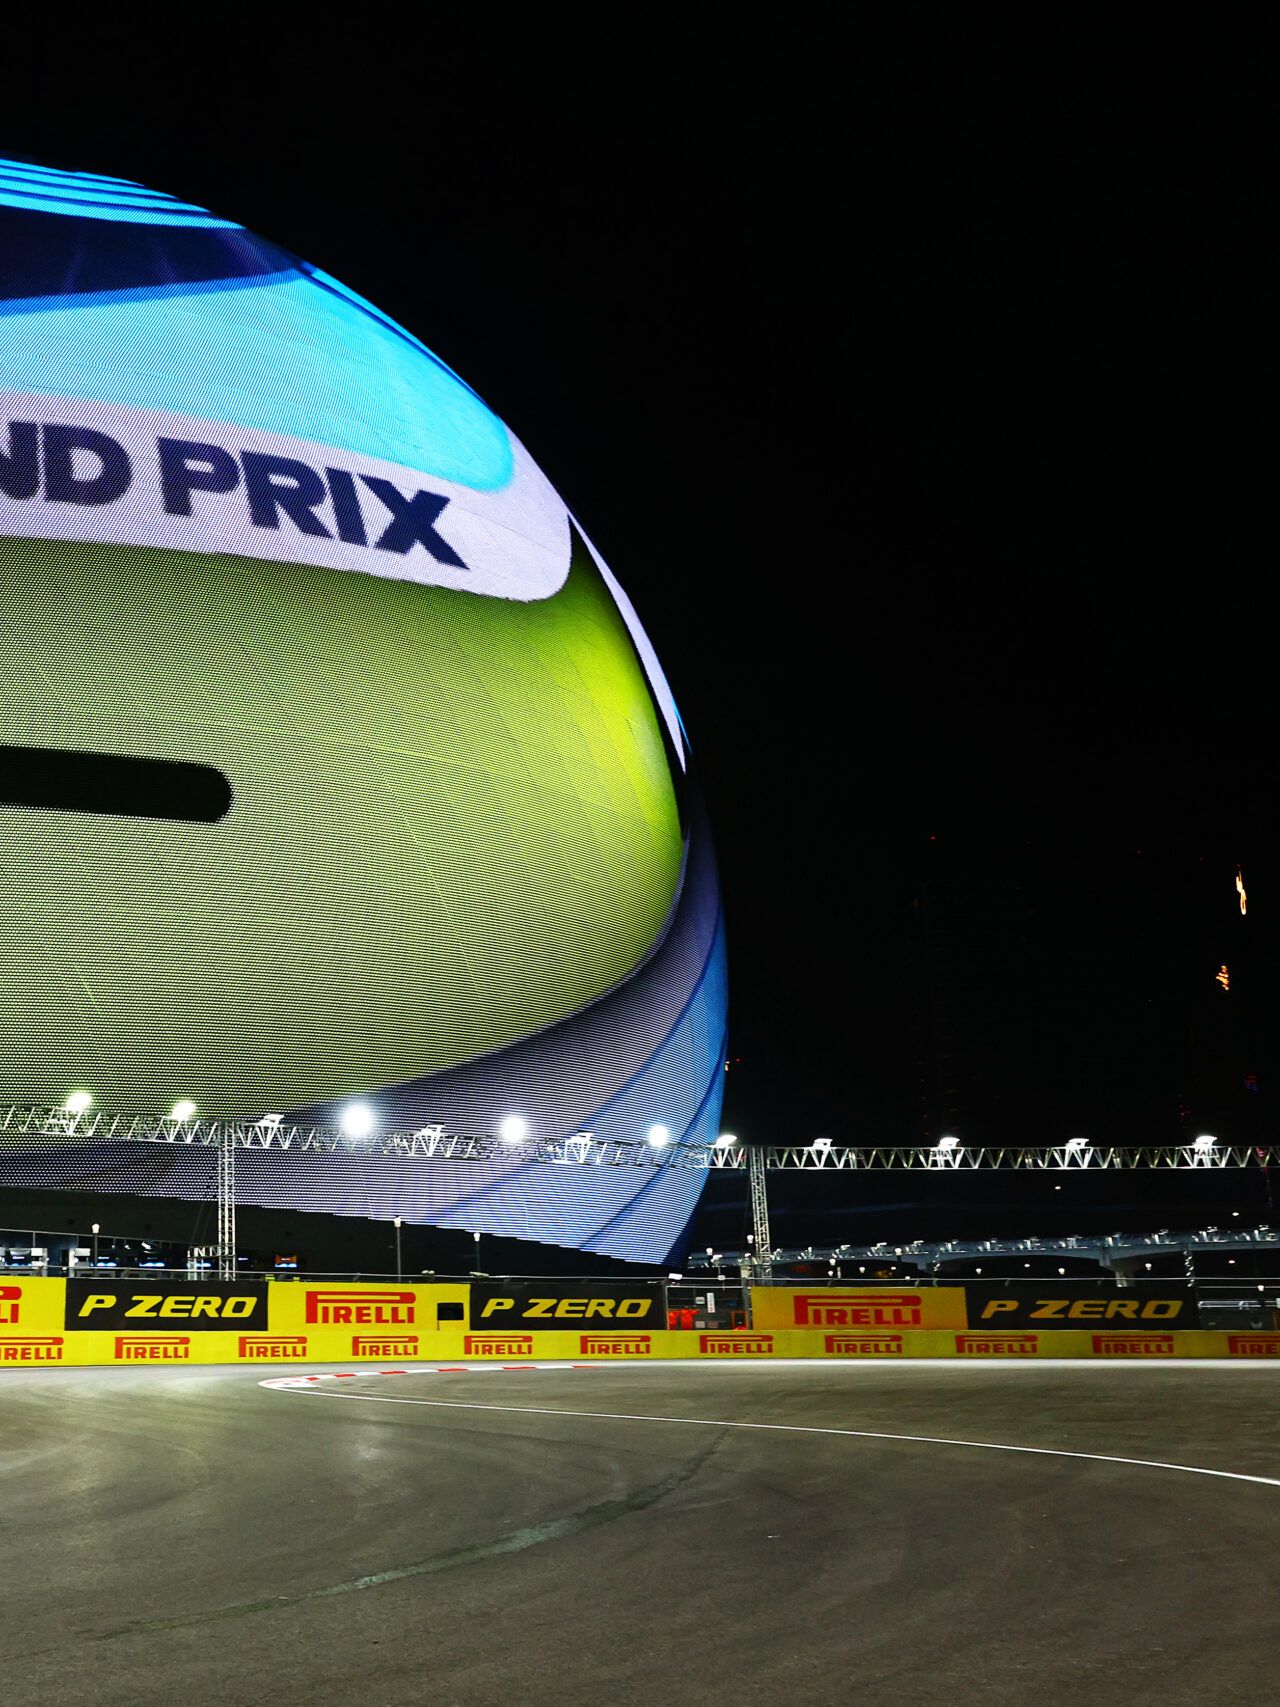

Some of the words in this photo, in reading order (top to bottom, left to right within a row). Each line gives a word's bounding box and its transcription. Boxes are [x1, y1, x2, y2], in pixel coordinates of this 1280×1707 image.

[158, 437, 468, 569] PRIX
[79, 1294, 117, 1318] P
[124, 1295, 258, 1318] ZERO
[305, 1290, 417, 1324] PIRELLI
[480, 1298, 515, 1318] P
[522, 1298, 652, 1318] ZERO
[793, 1295, 923, 1326] PIRELLI
[980, 1299, 1019, 1319] P
[1028, 1299, 1183, 1319] ZERO
[115, 1336, 190, 1359] PIRELLI
[239, 1336, 307, 1358] PIRELLI
[352, 1336, 419, 1356] PIRELLI
[464, 1335, 533, 1355] PIRELLI
[580, 1335, 652, 1355] PIRELLI
[700, 1335, 774, 1354] PIRELLI
[824, 1335, 902, 1354] PIRELLI
[955, 1335, 1038, 1354] PIRELLI
[1092, 1335, 1174, 1354] PIRELLI
